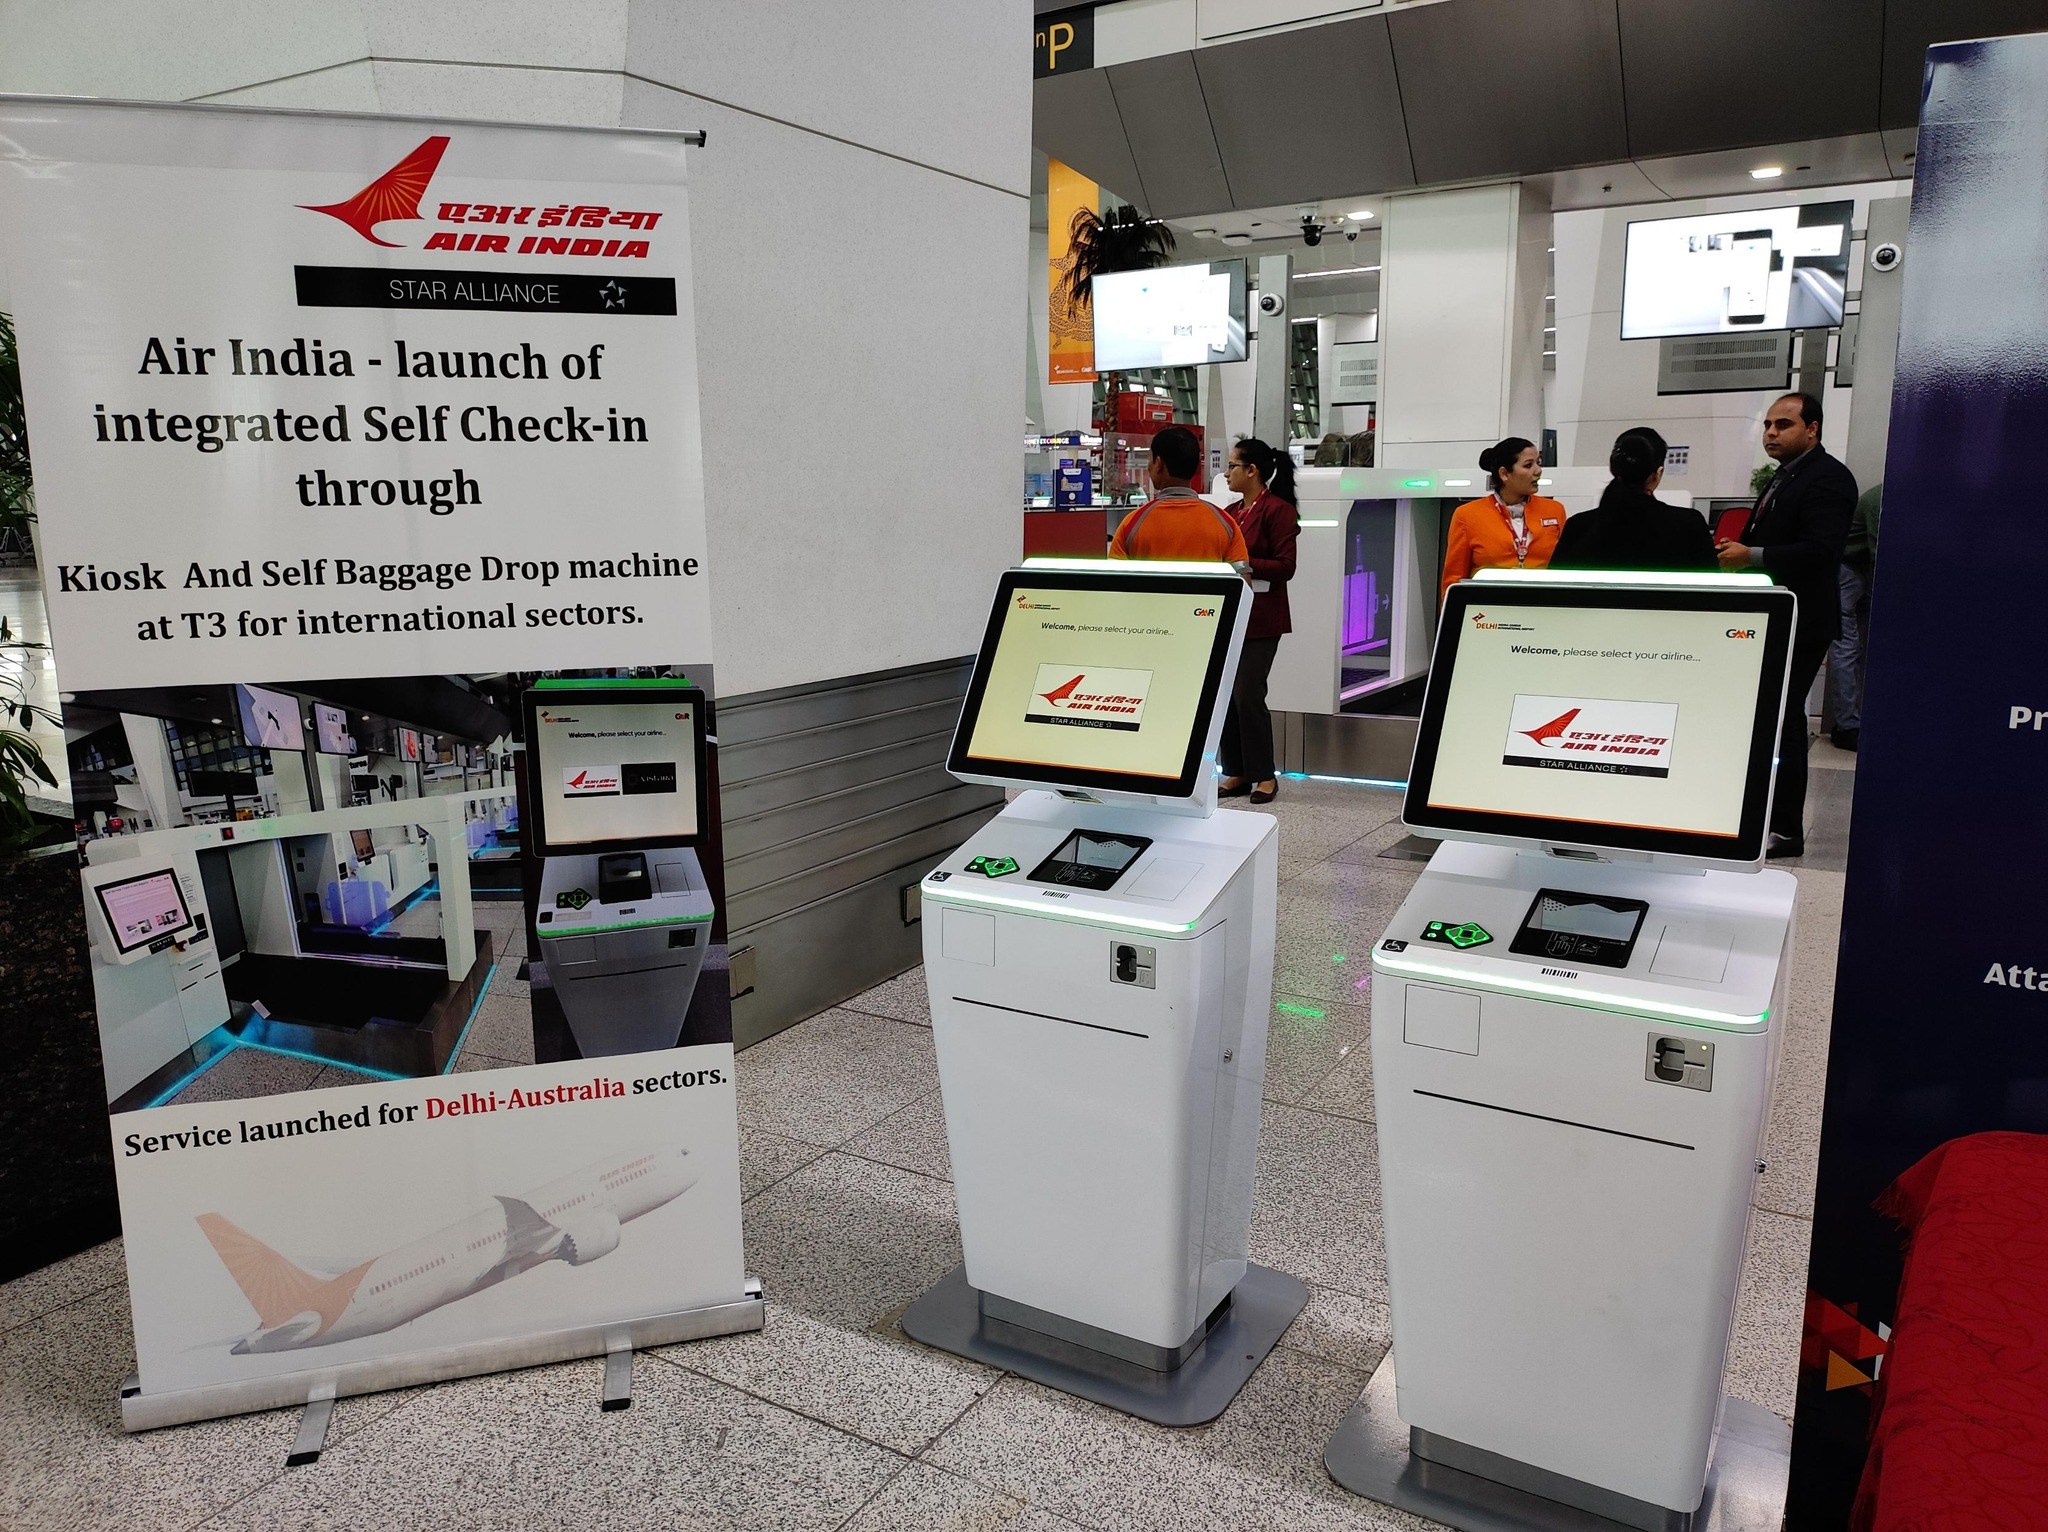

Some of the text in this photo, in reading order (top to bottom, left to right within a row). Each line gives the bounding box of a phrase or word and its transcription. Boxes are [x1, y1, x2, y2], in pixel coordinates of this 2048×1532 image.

[1050, 22, 1074, 69] P
[537, 204, 663, 230] इंडिया
[423, 232, 650, 258] AIR INDIA
[389, 279, 561, 304] STAR ALLIANCE
[138, 337, 215, 376] Air
[229, 337, 355, 377] India
[394, 340, 548, 380] launch
[561, 343, 605, 380] of
[94, 403, 649, 454] integrated Self Check-in
[296, 468, 482, 515] through
[58, 552, 699, 593] Kiosk And Self Baggage Drop machine
[137, 602, 644, 641] at T3 for international sectors.
[1194, 607, 1215, 617] GMR
[1041, 622, 1076, 632] Welcome,
[1078, 624, 1102, 633] please
[1104, 626, 1126, 634] select
[1128, 628, 1144, 636] your
[1476, 622, 1498, 630] DELHI
[1725, 628, 1756, 639] GMR
[1511, 645, 1701, 662] Welcome, please select your airline...
[1067, 702, 1136, 713] AIR INDIA
[568, 731, 597, 739] Welcome,
[598, 730, 616, 738] please
[634, 730, 646, 738] your
[1069, 719, 1104, 727] ALLIANCE
[1560, 742, 1660, 756] AIR INDIA
[1540, 760, 1616, 772] STAR ALLIANCE
[1983, 963, 2048, 992] Atta
[125, 1068, 727, 1157] Service launched for Delhi-Australia sectors.
